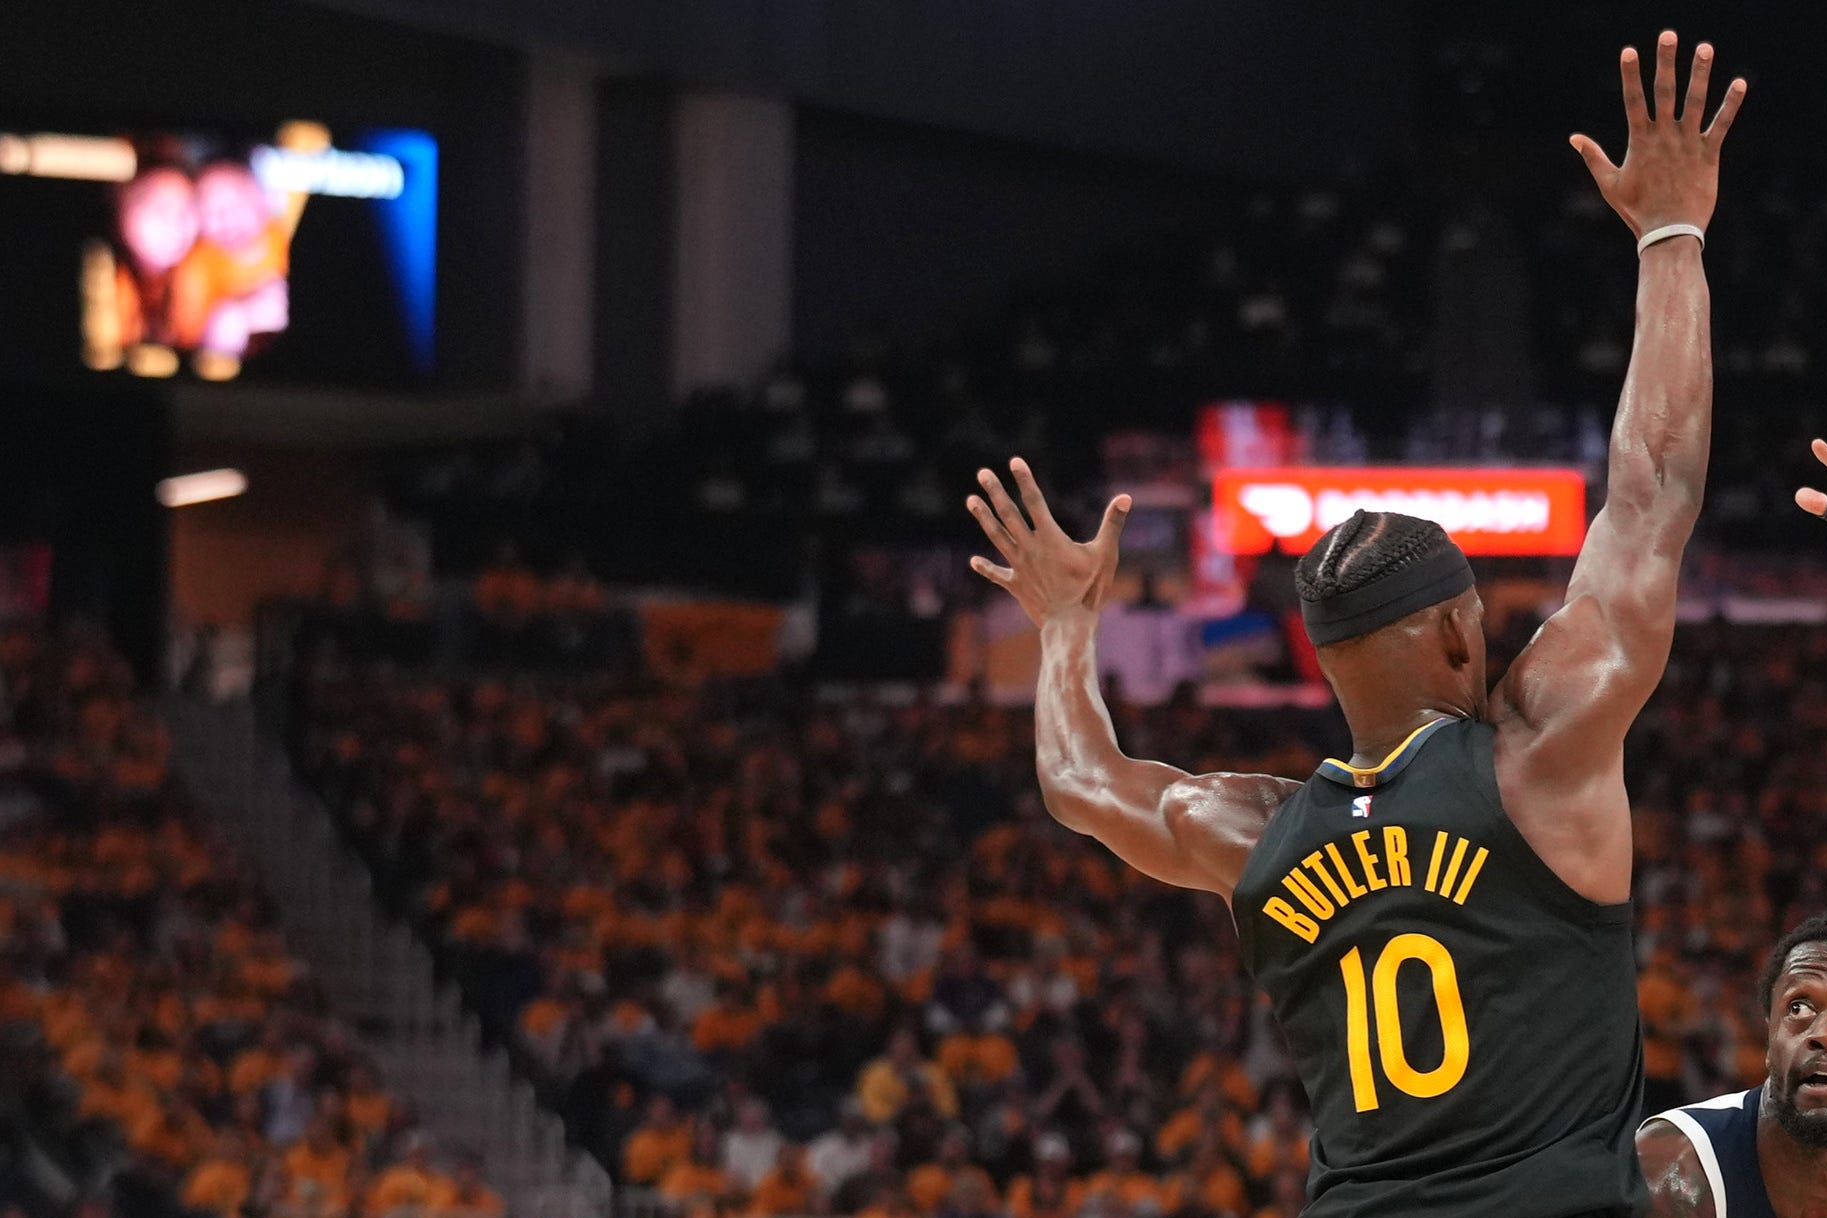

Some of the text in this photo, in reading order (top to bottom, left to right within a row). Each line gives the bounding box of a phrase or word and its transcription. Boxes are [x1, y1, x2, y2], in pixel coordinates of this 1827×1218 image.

[1262, 826, 1490, 943] BUTLER III
[1339, 933, 1470, 1113] 10
